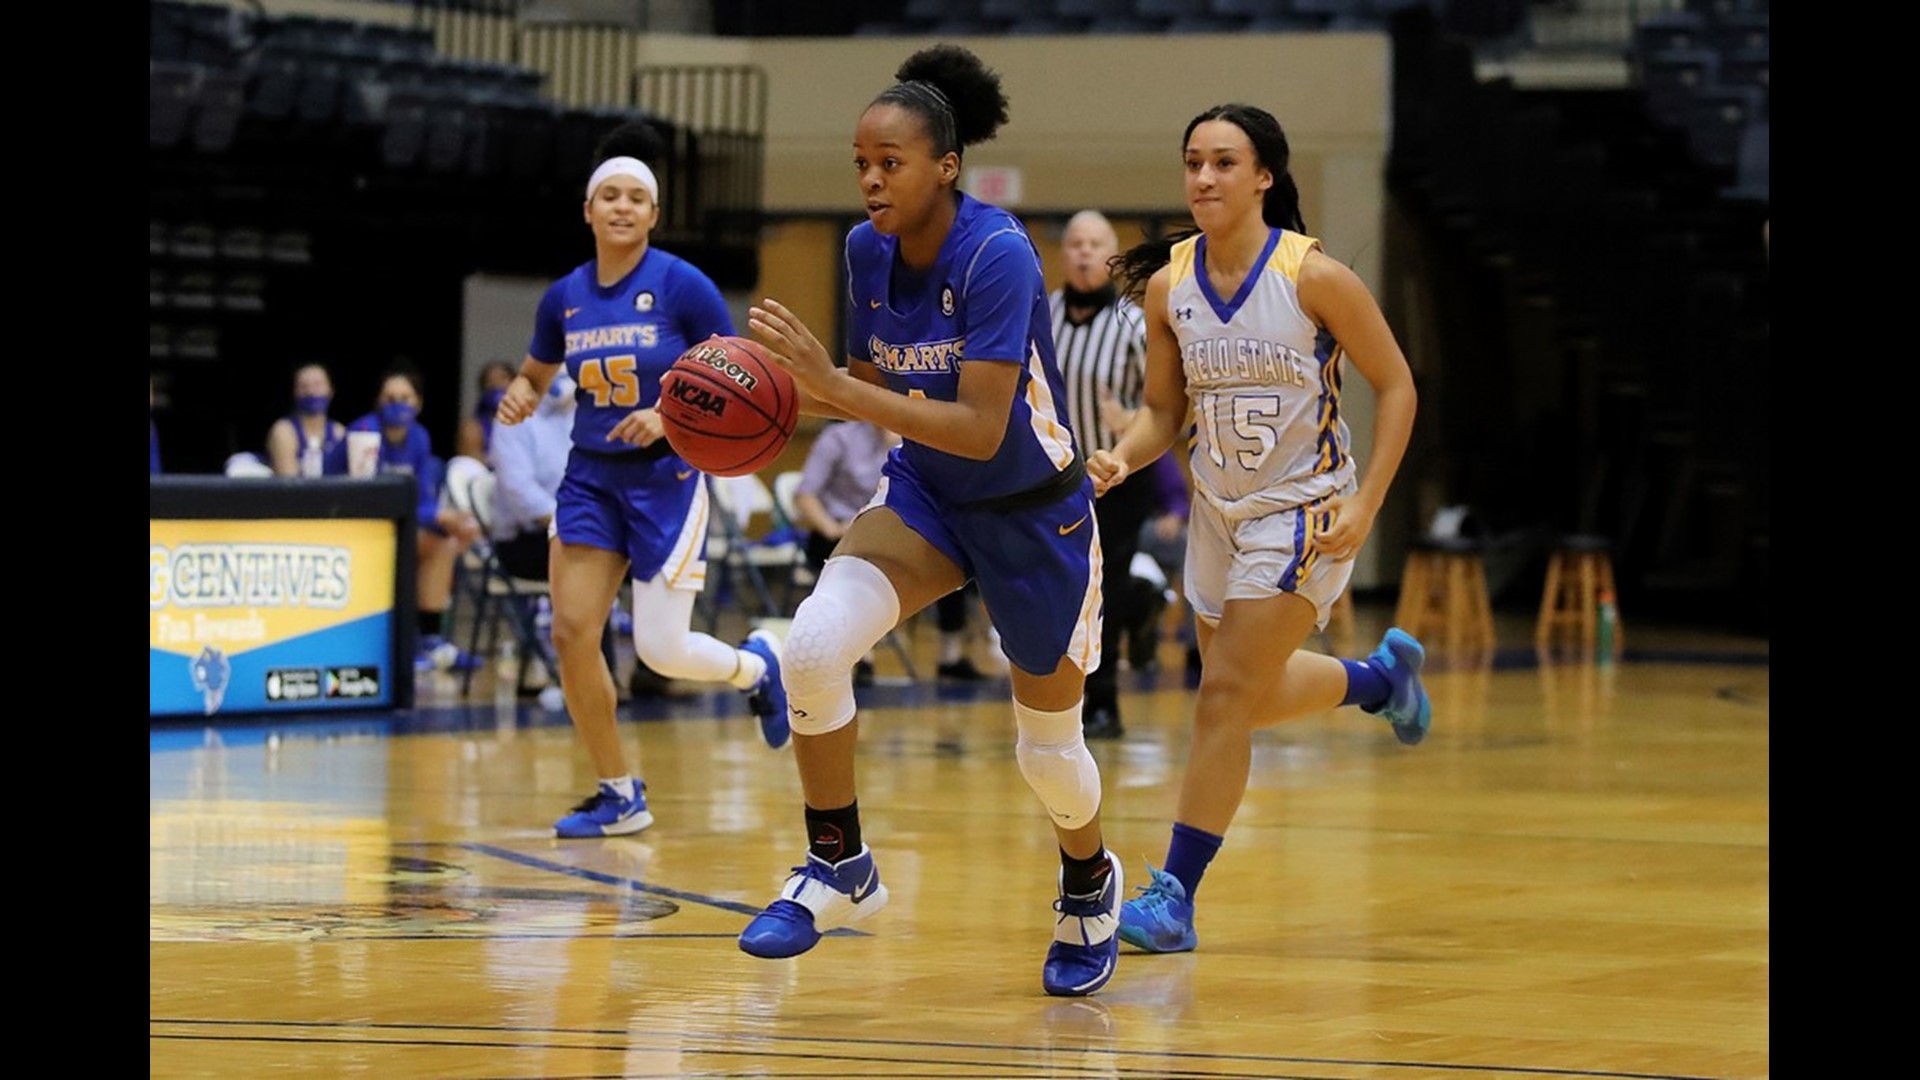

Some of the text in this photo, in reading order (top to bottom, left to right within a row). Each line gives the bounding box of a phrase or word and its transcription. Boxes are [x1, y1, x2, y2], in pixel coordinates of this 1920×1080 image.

[579, 354, 640, 408] 45
[681, 344, 759, 394] Wilson
[1236, 339, 1305, 389] STATE
[668, 378, 727, 417] NCAA
[1202, 391, 1281, 472] 15
